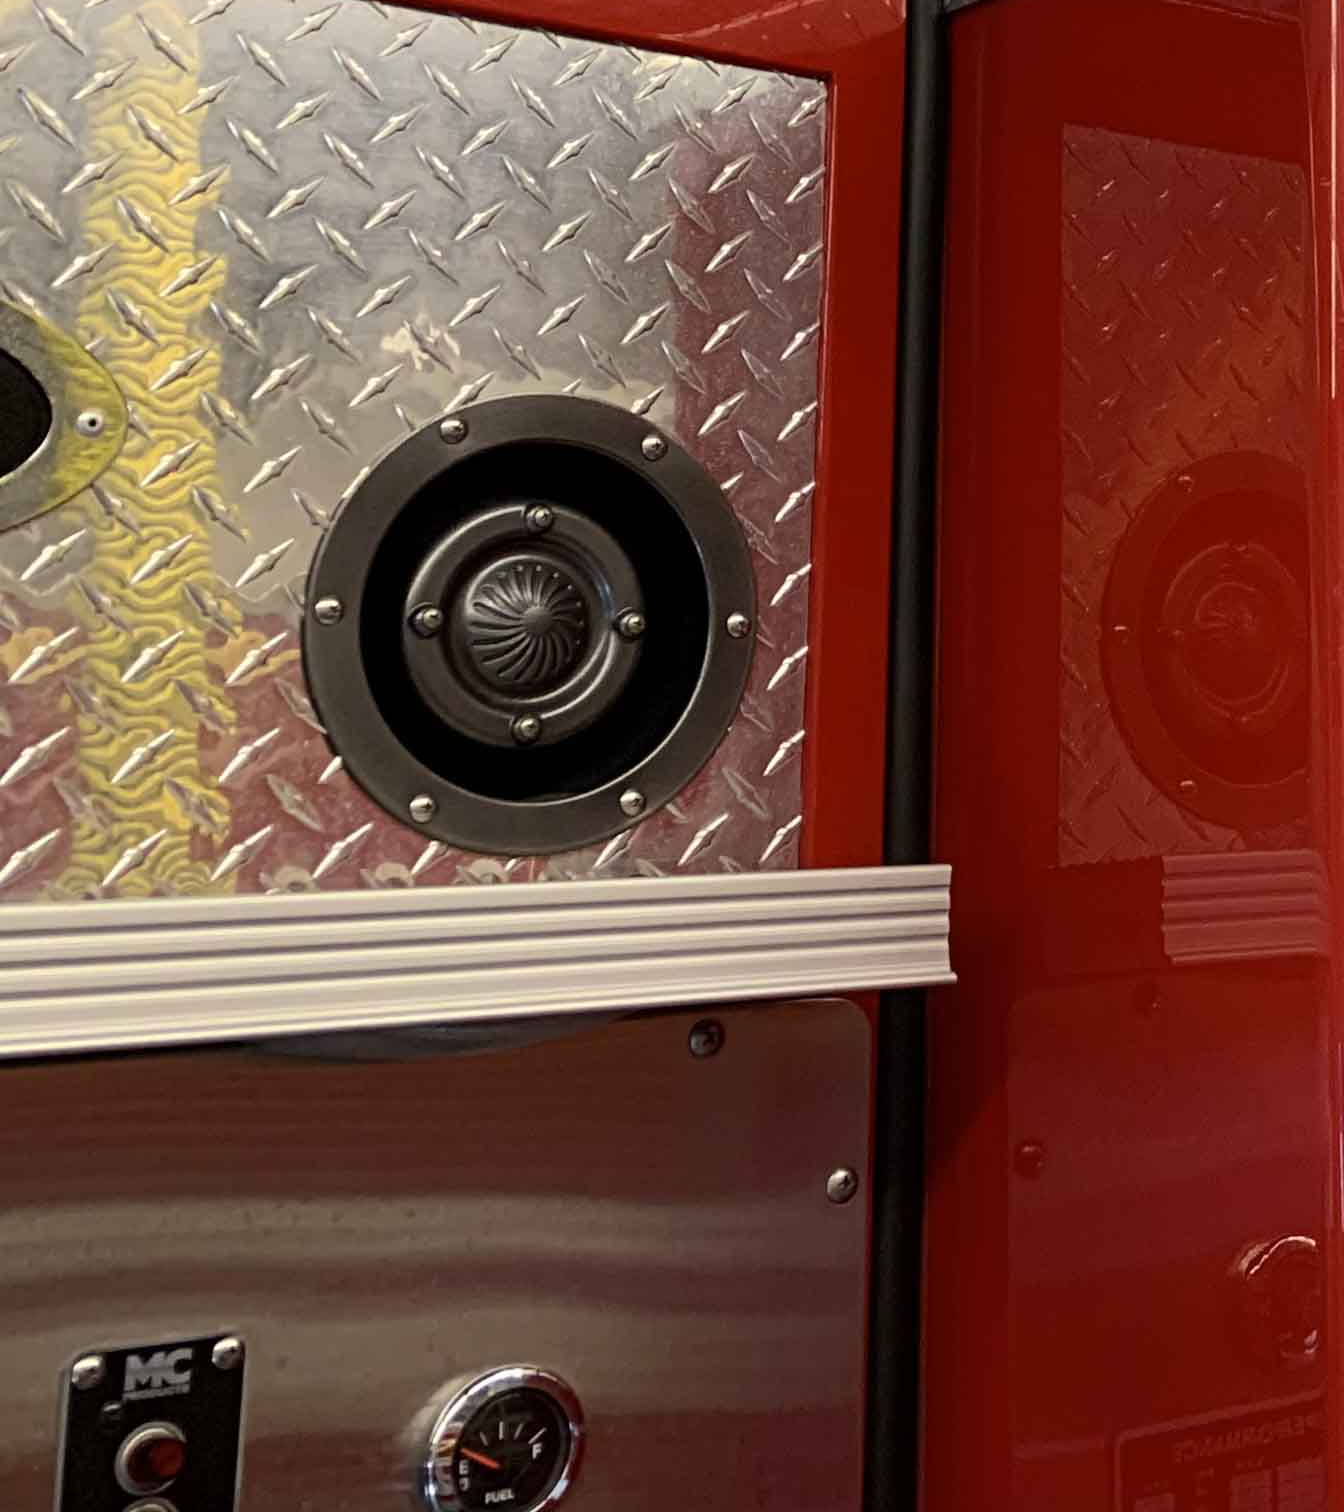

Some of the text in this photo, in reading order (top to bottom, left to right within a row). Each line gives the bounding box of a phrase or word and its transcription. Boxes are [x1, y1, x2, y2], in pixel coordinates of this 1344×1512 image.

[124, 1348, 193, 1391] MC
[532, 1442, 543, 1459] F
[459, 1460, 469, 1475] E
[484, 1489, 515, 1504] FUEL
